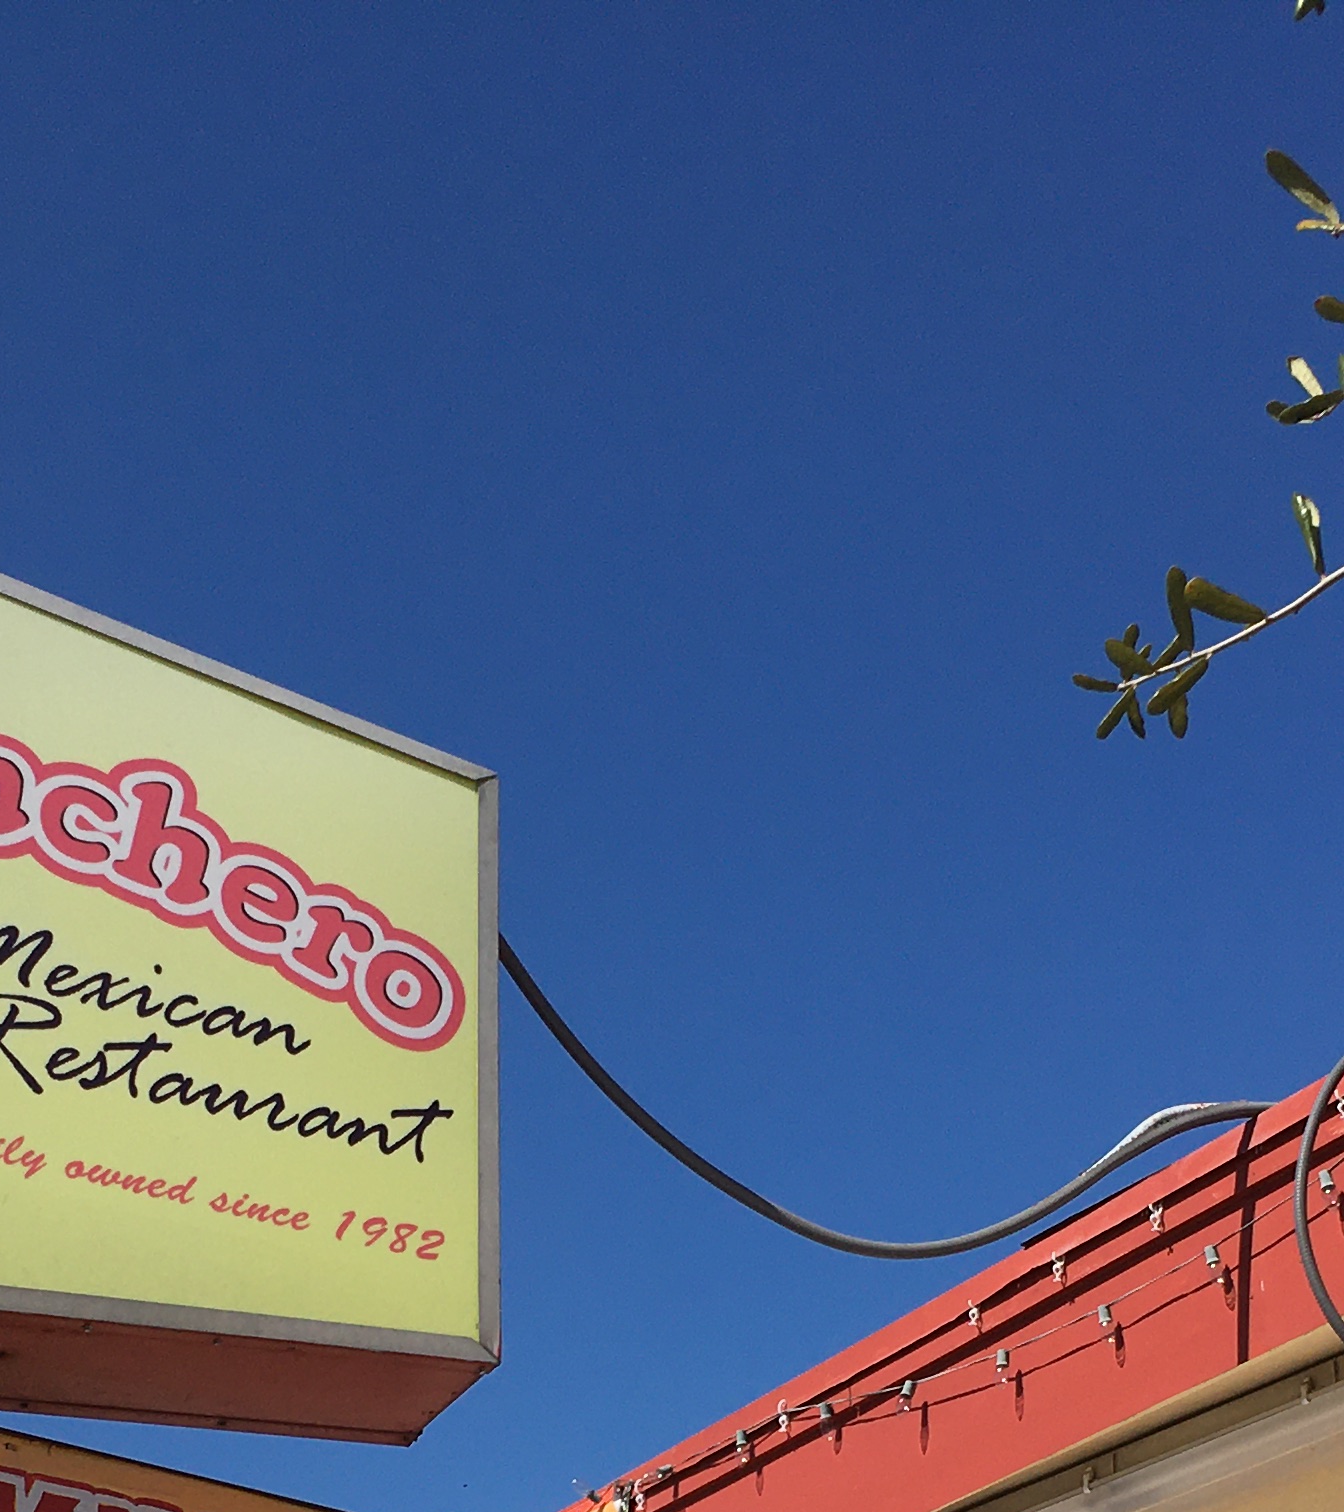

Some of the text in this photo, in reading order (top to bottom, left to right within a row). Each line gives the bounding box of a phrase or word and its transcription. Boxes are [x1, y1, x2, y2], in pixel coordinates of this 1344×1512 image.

[64, 1159, 198, 1205] owned
[210, 1188, 311, 1232] since
[334, 1210, 446, 1261] 1982
